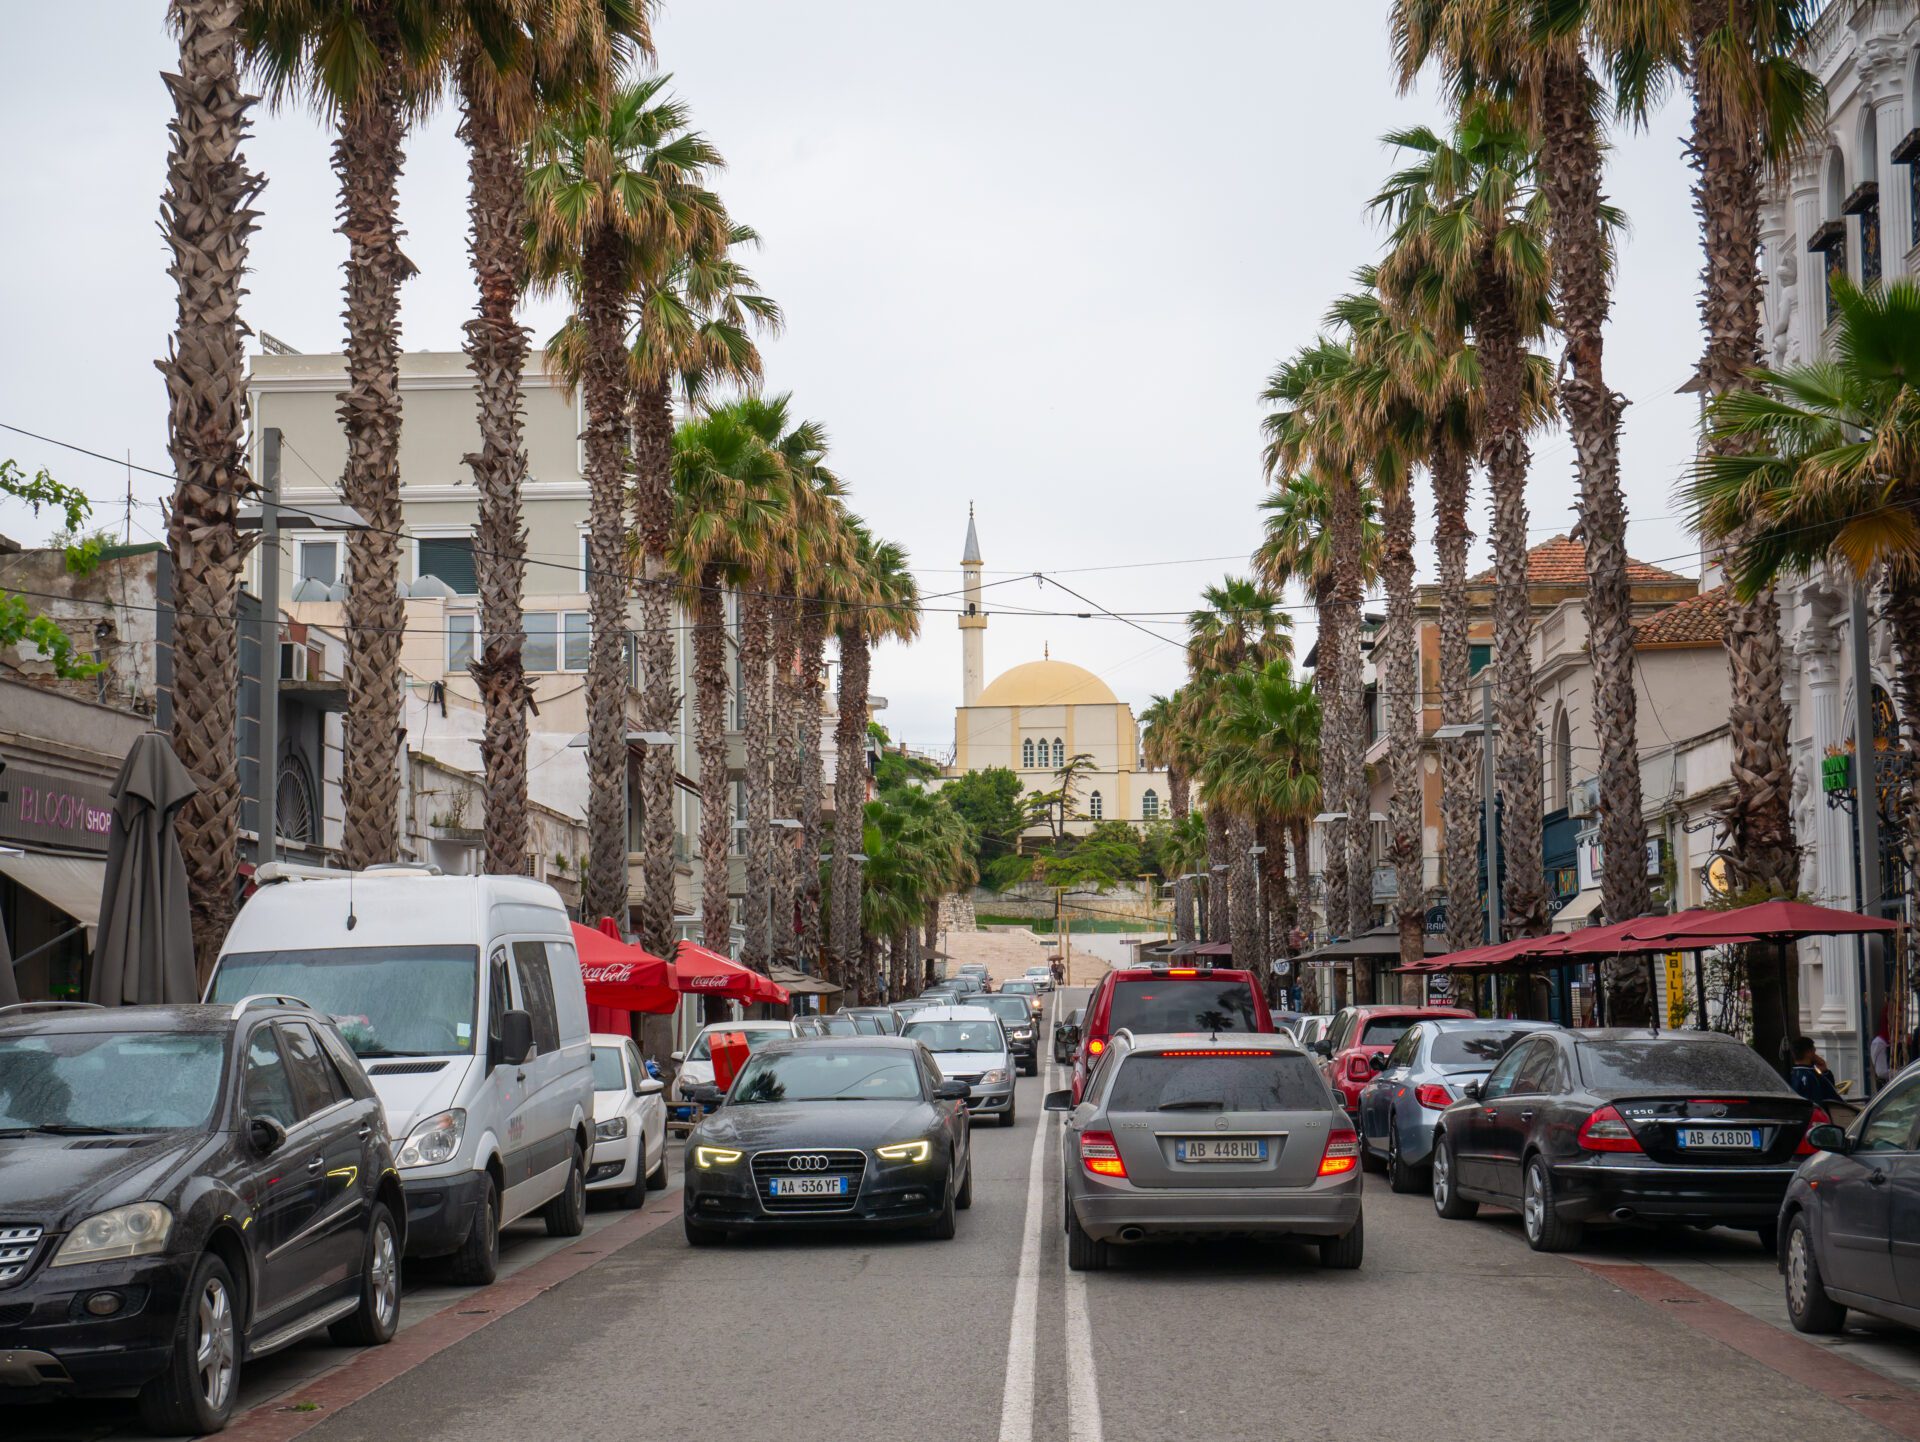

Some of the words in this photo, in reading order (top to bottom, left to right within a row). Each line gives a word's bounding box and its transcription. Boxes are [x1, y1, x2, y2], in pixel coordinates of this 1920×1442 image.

[20, 786, 85, 829] BLOOM
[86, 809, 112, 832] SHOP
[691, 975, 729, 987] Coca-Cola
[1280, 989, 1288, 1012] REN
[1689, 1131, 1704, 1145] AB
[1189, 1142, 1206, 1157] AB
[781, 1180, 795, 1193] AA
